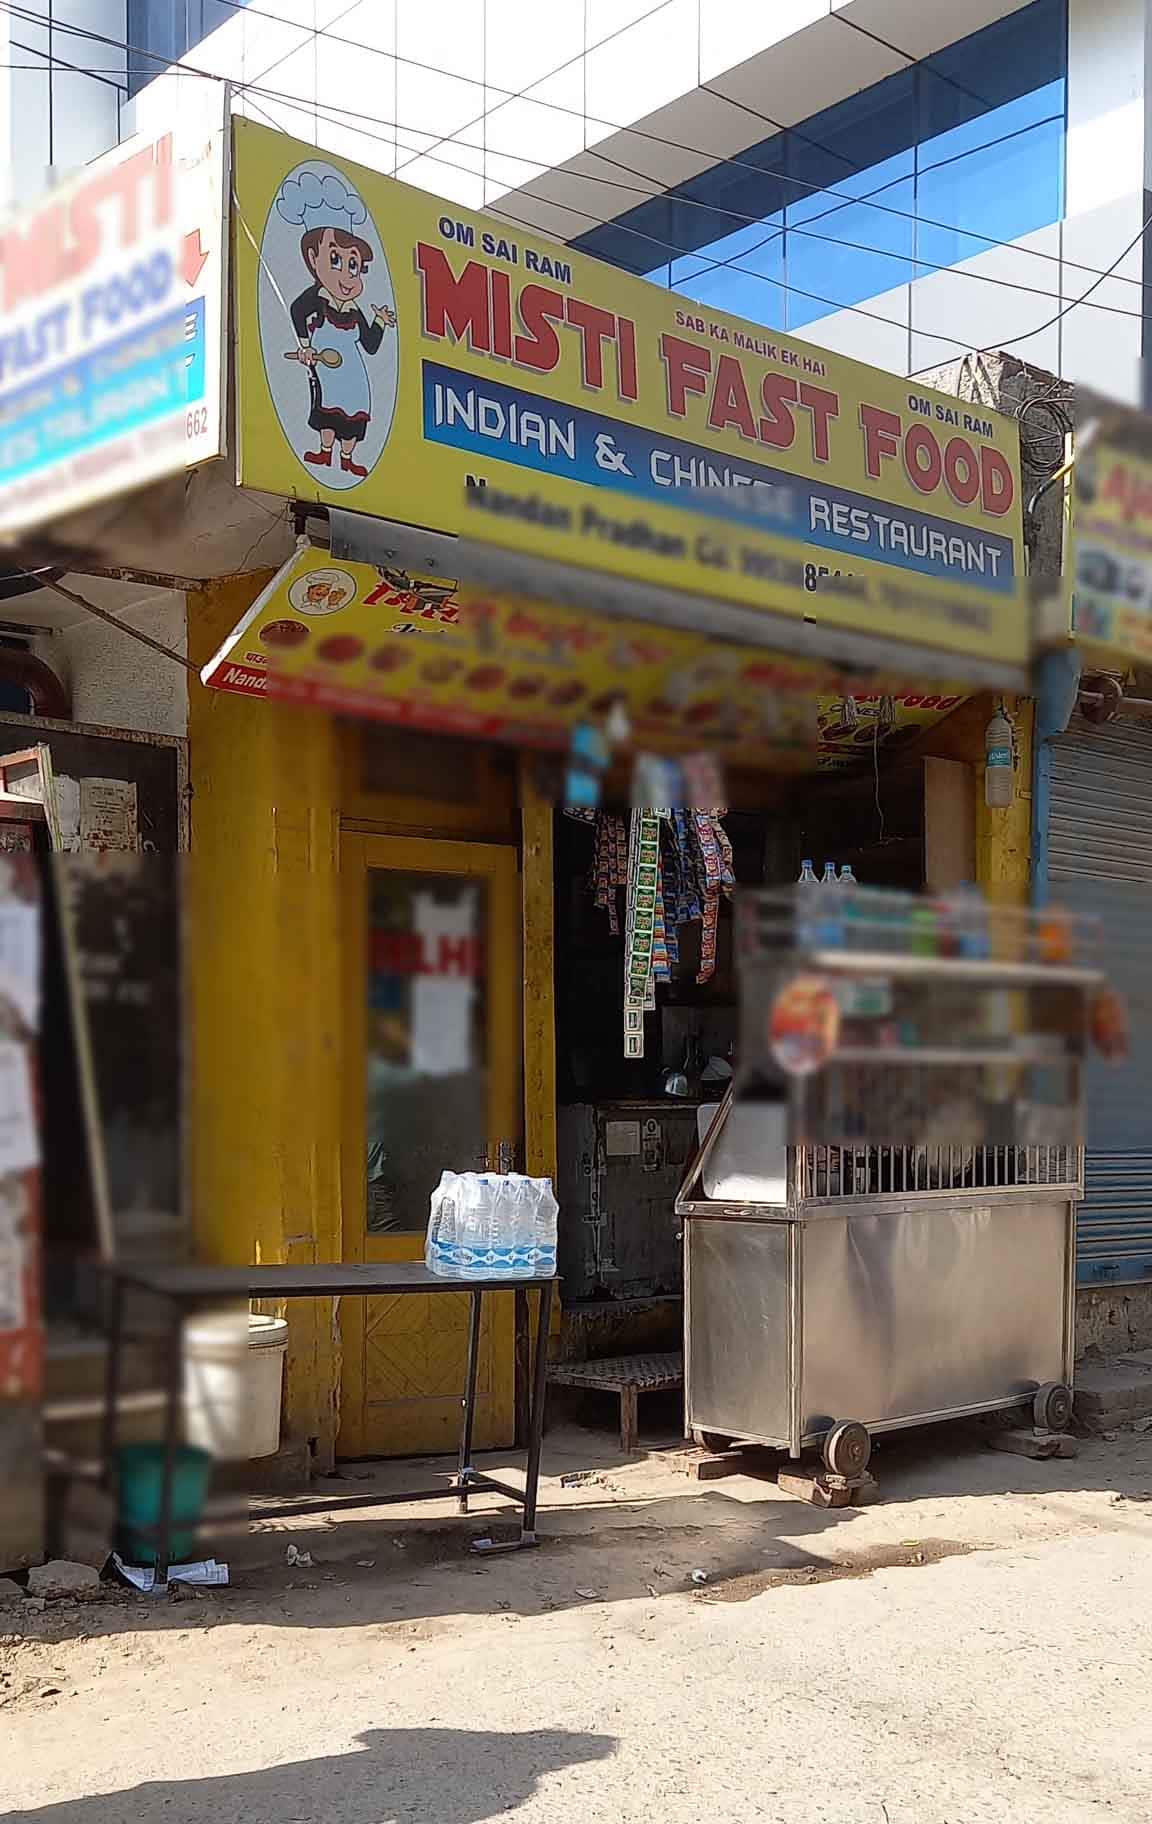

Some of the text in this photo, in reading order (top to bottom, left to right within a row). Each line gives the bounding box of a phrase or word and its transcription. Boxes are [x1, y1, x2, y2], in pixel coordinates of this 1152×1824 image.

[438, 216, 571, 285] OM SAI RAM
[416, 240, 638, 401] MISTI
[661, 332, 839, 462] FAST
[860, 402, 1014, 516] FOOD
[675, 310, 826, 377] SAB KA MALIK EK HAI
[907, 395, 993, 438] OM SAI RAM
[434, 383, 576, 460] INDIAN
[594, 433, 634, 477] &
[809, 495, 1002, 578] RESTAURANT
